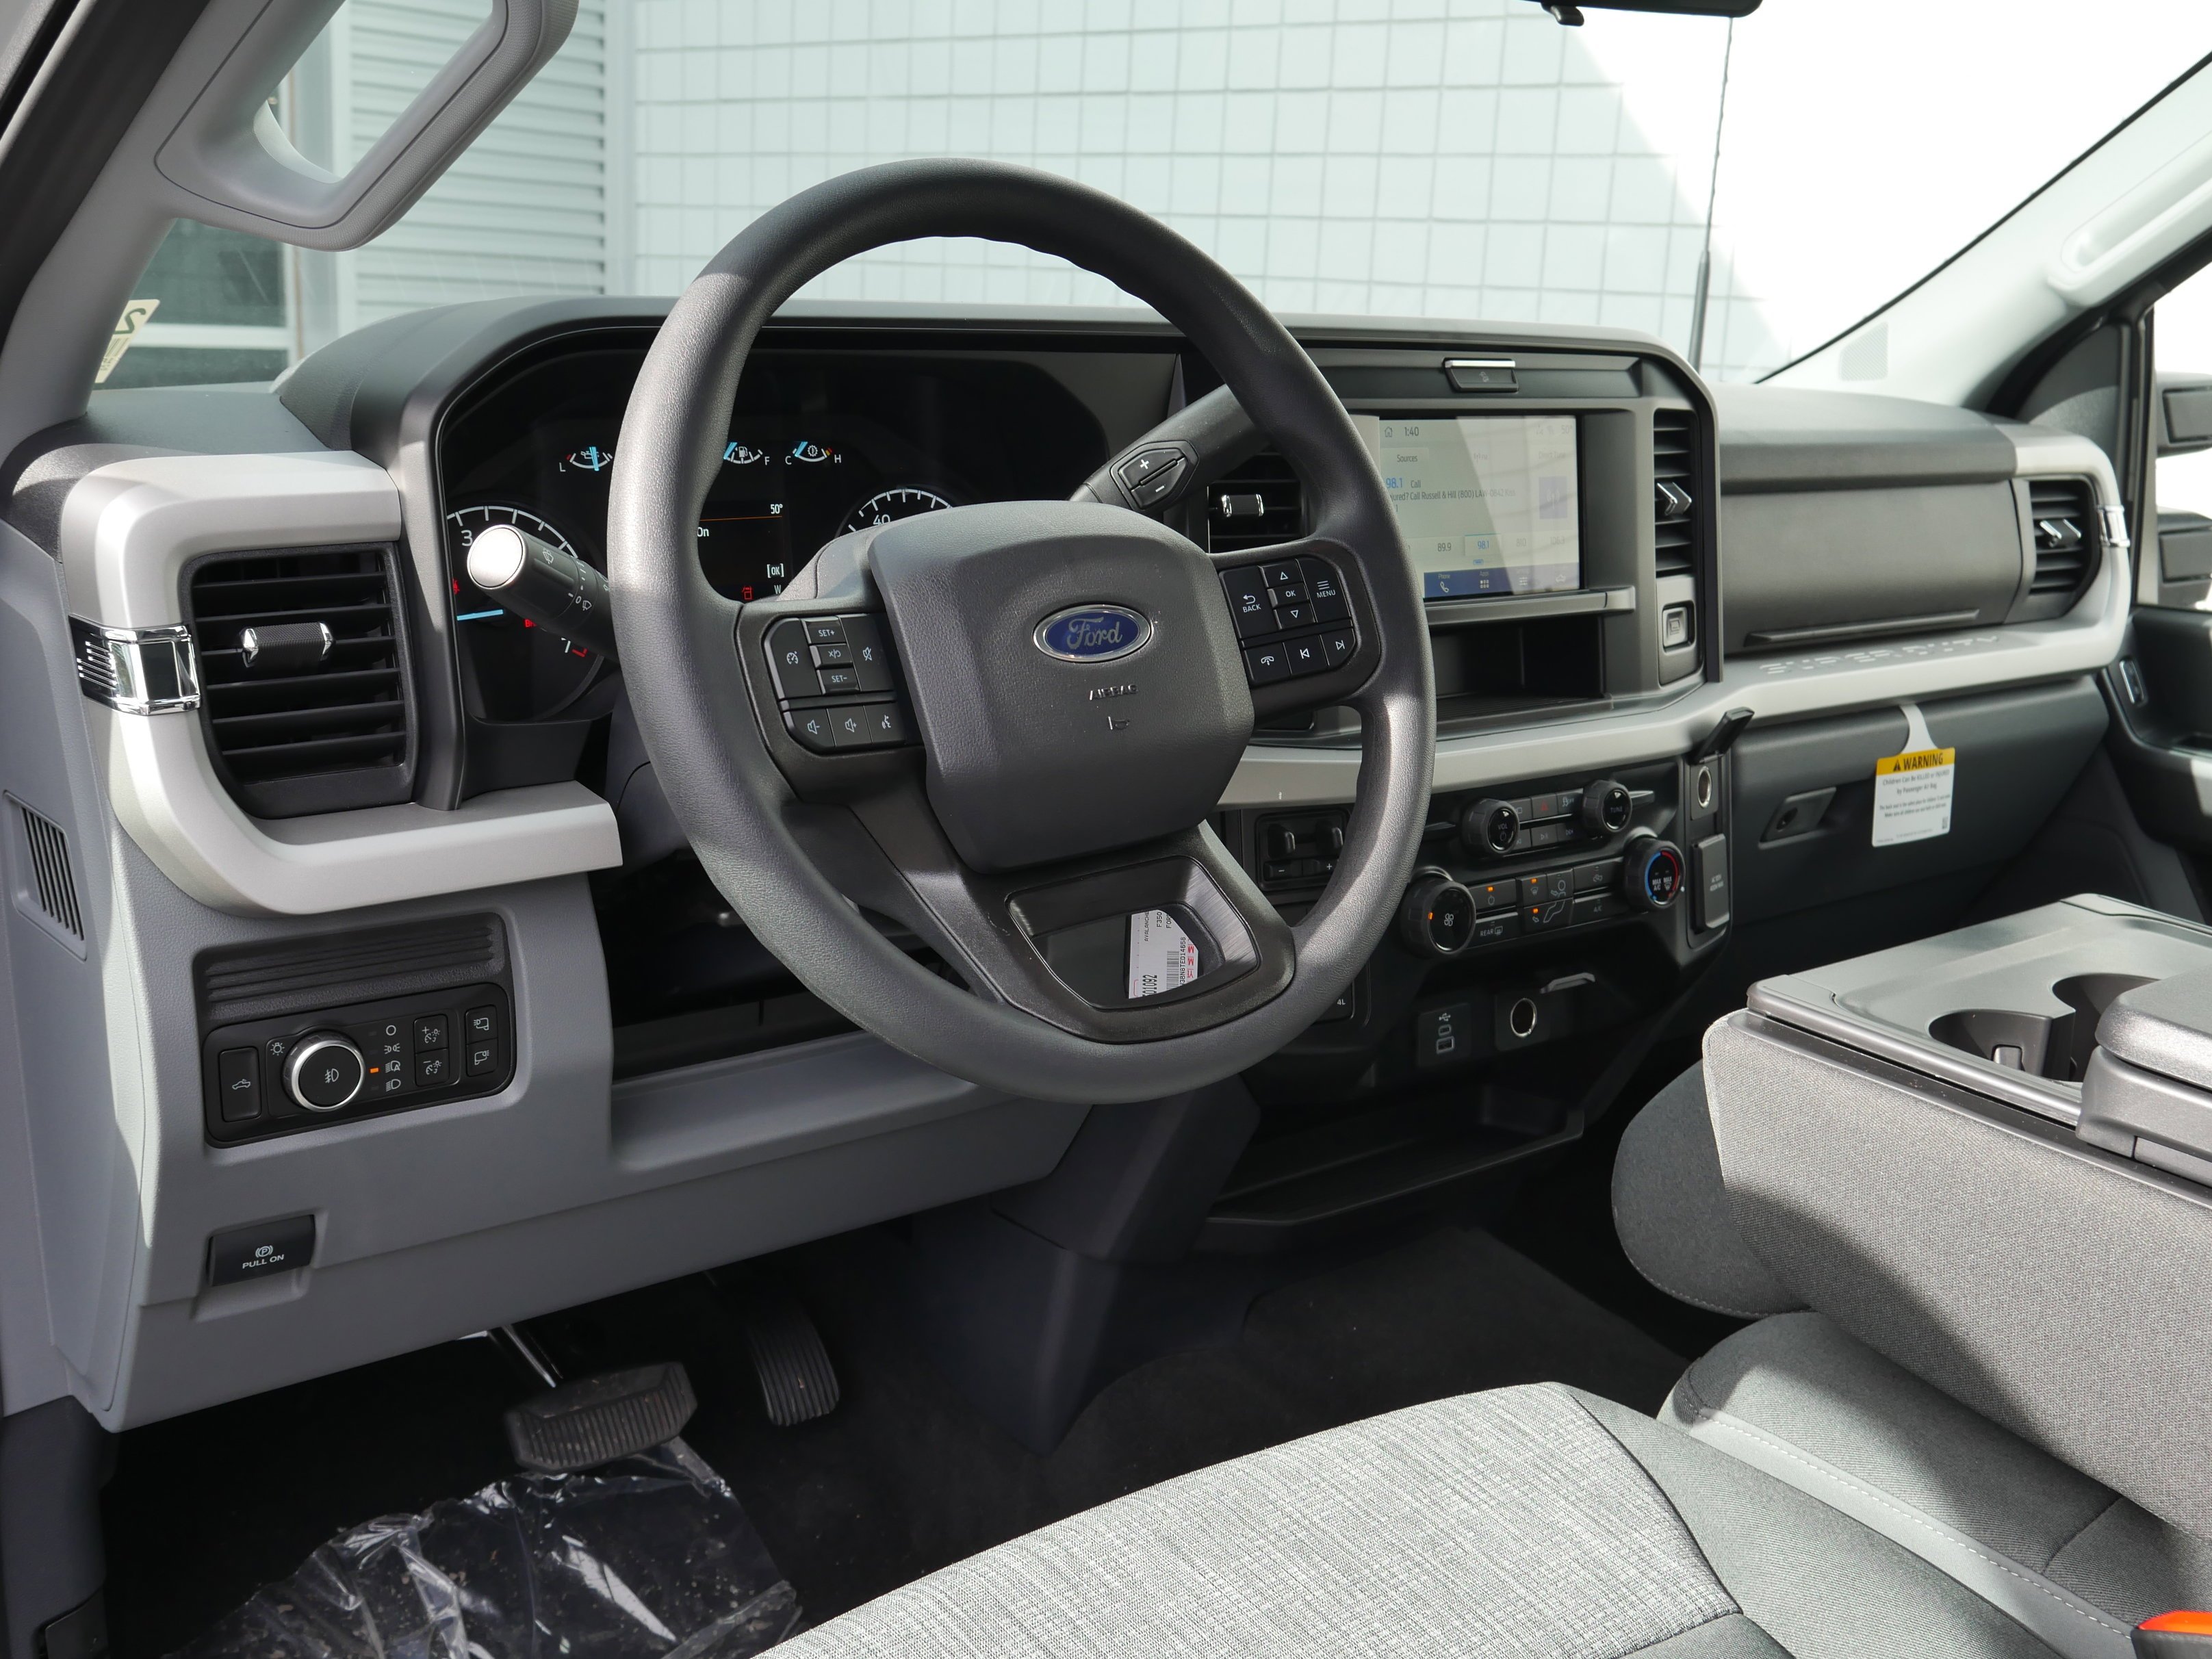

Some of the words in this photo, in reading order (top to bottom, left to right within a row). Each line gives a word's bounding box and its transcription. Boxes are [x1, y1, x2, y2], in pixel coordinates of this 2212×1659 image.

[1404, 426, 1420, 437] 1:40
[764, 456, 771, 466] F
[785, 455, 793, 465] C
[834, 454, 842, 464] H
[1396, 454, 1418, 463] Sources
[558, 461, 566, 472] L
[1386, 477, 1403, 489] 98.1
[1410, 479, 1422, 489] Call
[1410, 491, 1421, 501] Call
[1422, 491, 1441, 500] Russell
[1442, 491, 1447, 500] &
[1448, 489, 1457, 500] Hill
[770, 503, 784, 515] 50°
[873, 513, 891, 526] 40
[461, 529, 473, 547] 3
[1437, 541, 1452, 552] 89.9
[1477, 539, 1490, 550] 98.1
[1285, 590, 1296, 598] OK
[1316, 589, 1336, 599] MENU
[1242, 603, 1261, 613] BACK
[818, 629, 835, 638] SET+
[1066, 616, 1123, 650] Ford
[1089, 684, 1139, 701] AIRBAG
[1903, 753, 1943, 771] WARNING
[1480, 928, 1494, 937] REAR
[1336, 999, 1346, 1007] 4L
[242, 1258, 268, 1270] PULL
[269, 1254, 285, 1263] ON
